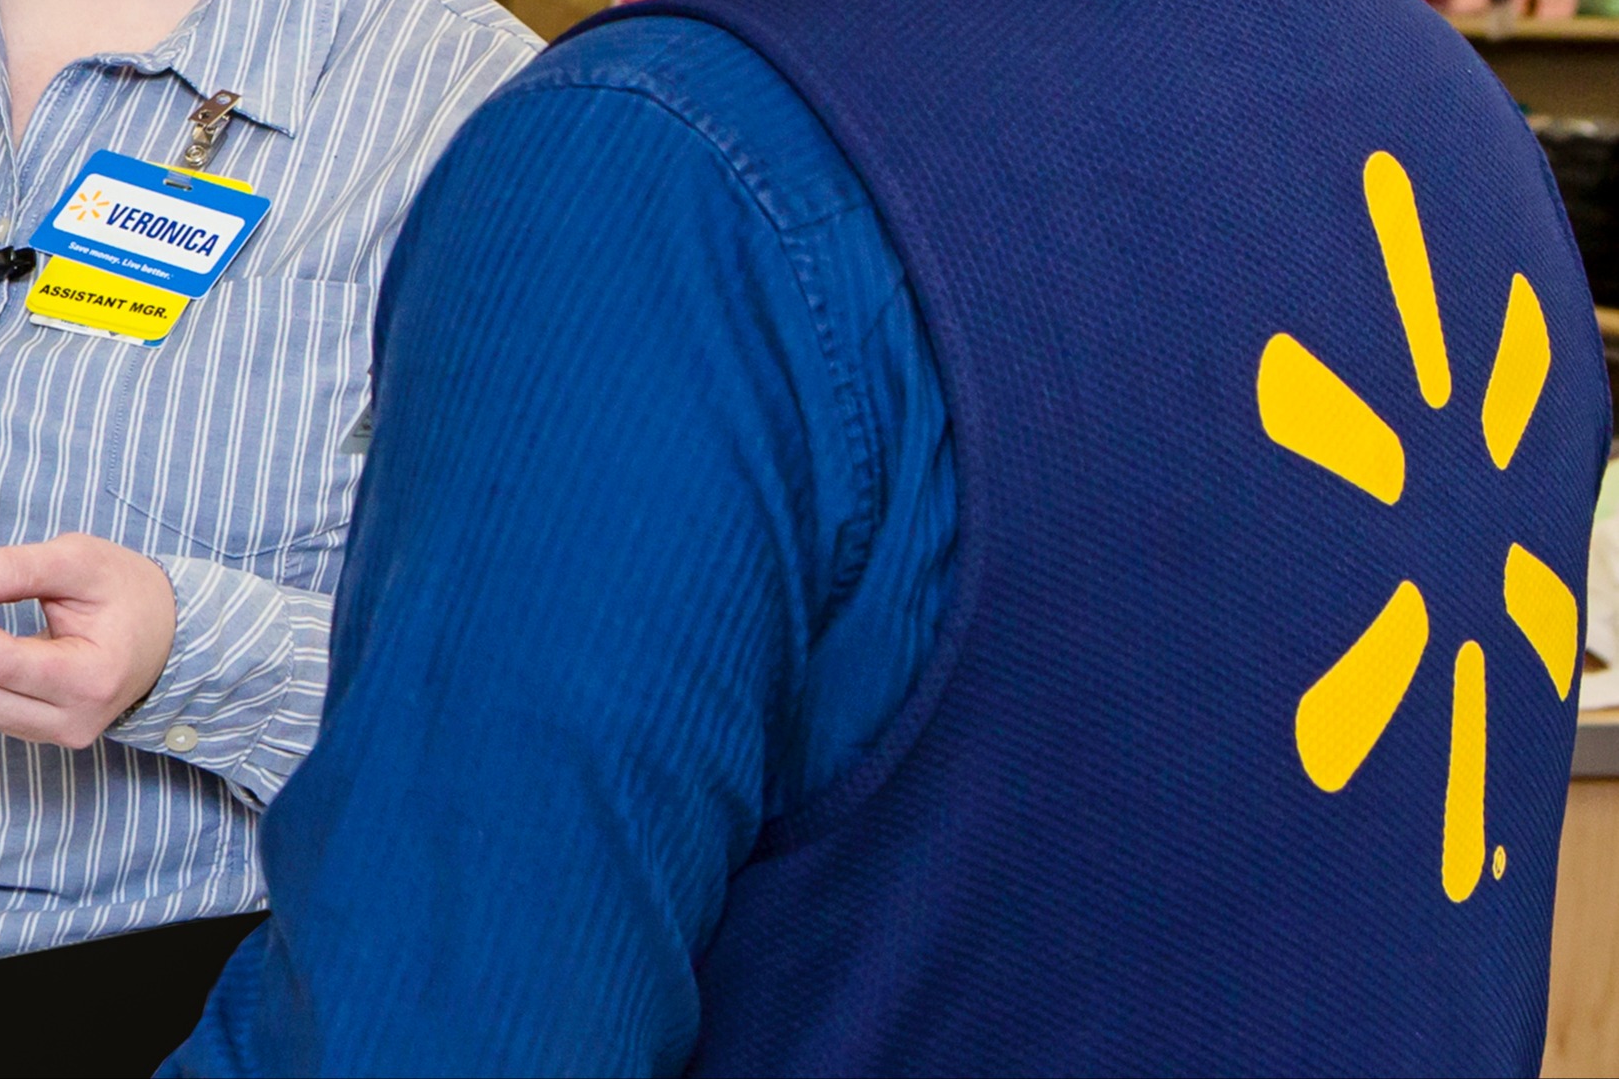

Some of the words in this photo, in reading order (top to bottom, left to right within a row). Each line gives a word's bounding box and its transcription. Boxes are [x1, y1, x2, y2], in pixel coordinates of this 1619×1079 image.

[106, 203, 220, 257] VERONICA
[68, 241, 89, 254] Save
[89, 247, 121, 265] money.
[122, 258, 141, 270] Live
[140, 262, 171, 280] better.
[38, 284, 127, 310] ASSISTANT
[129, 302, 169, 320] MGR.
